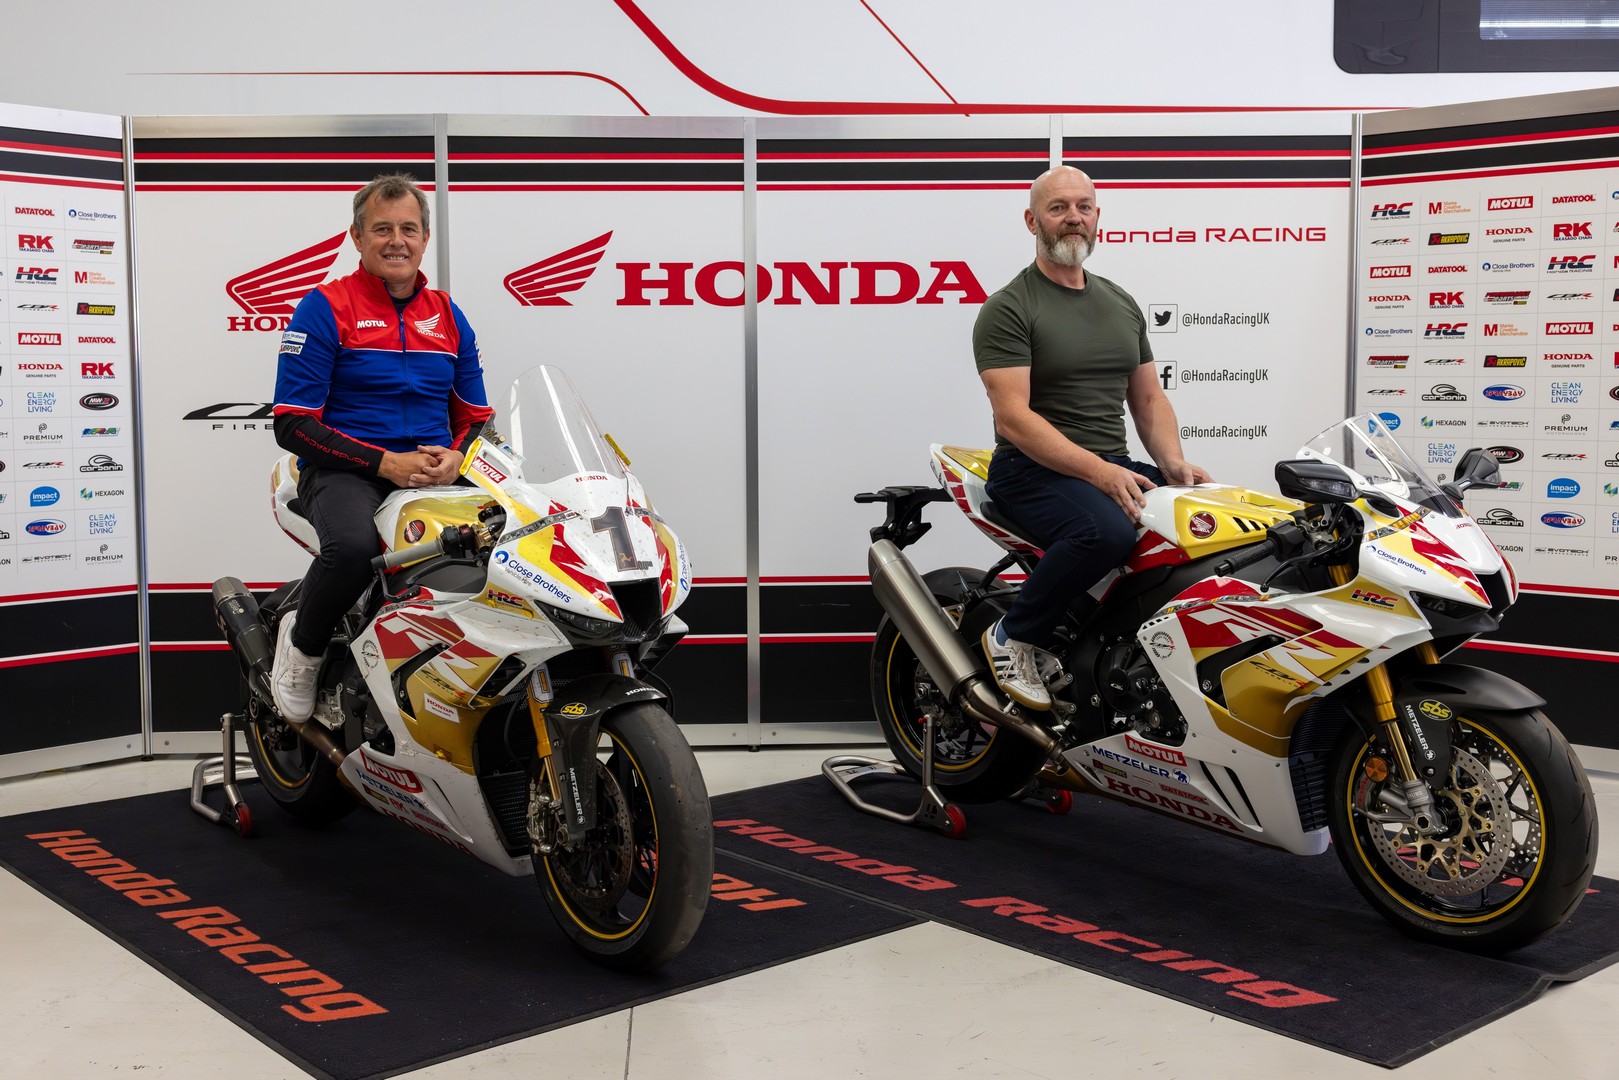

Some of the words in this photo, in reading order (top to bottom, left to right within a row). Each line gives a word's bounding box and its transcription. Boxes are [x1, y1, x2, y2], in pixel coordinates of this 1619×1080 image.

[1490, 198, 1531, 209] MOTUL
[1552, 195, 1596, 204] DATATOOL
[15, 207, 54, 216] DATATOOL
[1372, 202, 1413, 217] HRC
[1206, 227, 1326, 243] RACING
[1486, 227, 1533, 236] HONDA
[1553, 222, 1592, 238] RK
[18, 234, 54, 249] RK
[1548, 255, 1596, 270] HRC
[16, 267, 59, 281] HRC
[1371, 267, 1409, 277] MOTUL
[616, 261, 988, 307] HONDA
[1429, 292, 1464, 305] RK
[227, 316, 294, 332] HON
[357, 320, 388, 329] MOTUL
[1182, 312, 1270, 327] @HondaRacingUK
[416, 329, 446, 339] HONDA
[1424, 323, 1468, 336] HRC
[1548, 324, 1591, 334] MOTUL
[20, 335, 60, 344] MOTUL
[81, 363, 114, 376] RK
[1181, 369, 1268, 383] @HondaRacingUK
[1180, 425, 1267, 440] @HondaRacingUK
[474, 458, 503, 482] MOTUL
[1550, 484, 1578, 493] impact
[591, 506, 639, 572] 1
[1376, 550, 1397, 562] Close
[1398, 554, 1426, 575] Brothers
[508, 559, 533, 579] Close
[534, 574, 572, 604] Brothers
[488, 589, 524, 607] HRC
[1352, 589, 1398, 607] HRC
[427, 698, 454, 714] HONDA
[562, 703, 585, 715] sbs
[1420, 702, 1450, 719] sbs
[1405, 704, 1429, 750] METZELER
[1128, 740, 1183, 764] MOTUL
[1092, 745, 1170, 778] METZELER
[366, 758, 417, 788] MOTUL
[570, 767, 582, 815] METZELER
[1159, 783, 1206, 805] DATATOOL
[1104, 775, 1244, 833] HONDA
[712, 819, 958, 891] Honda
[959, 896, 1339, 1008] Racing
[25, 830, 191, 906] Honda
[156, 905, 389, 1022] Racing
